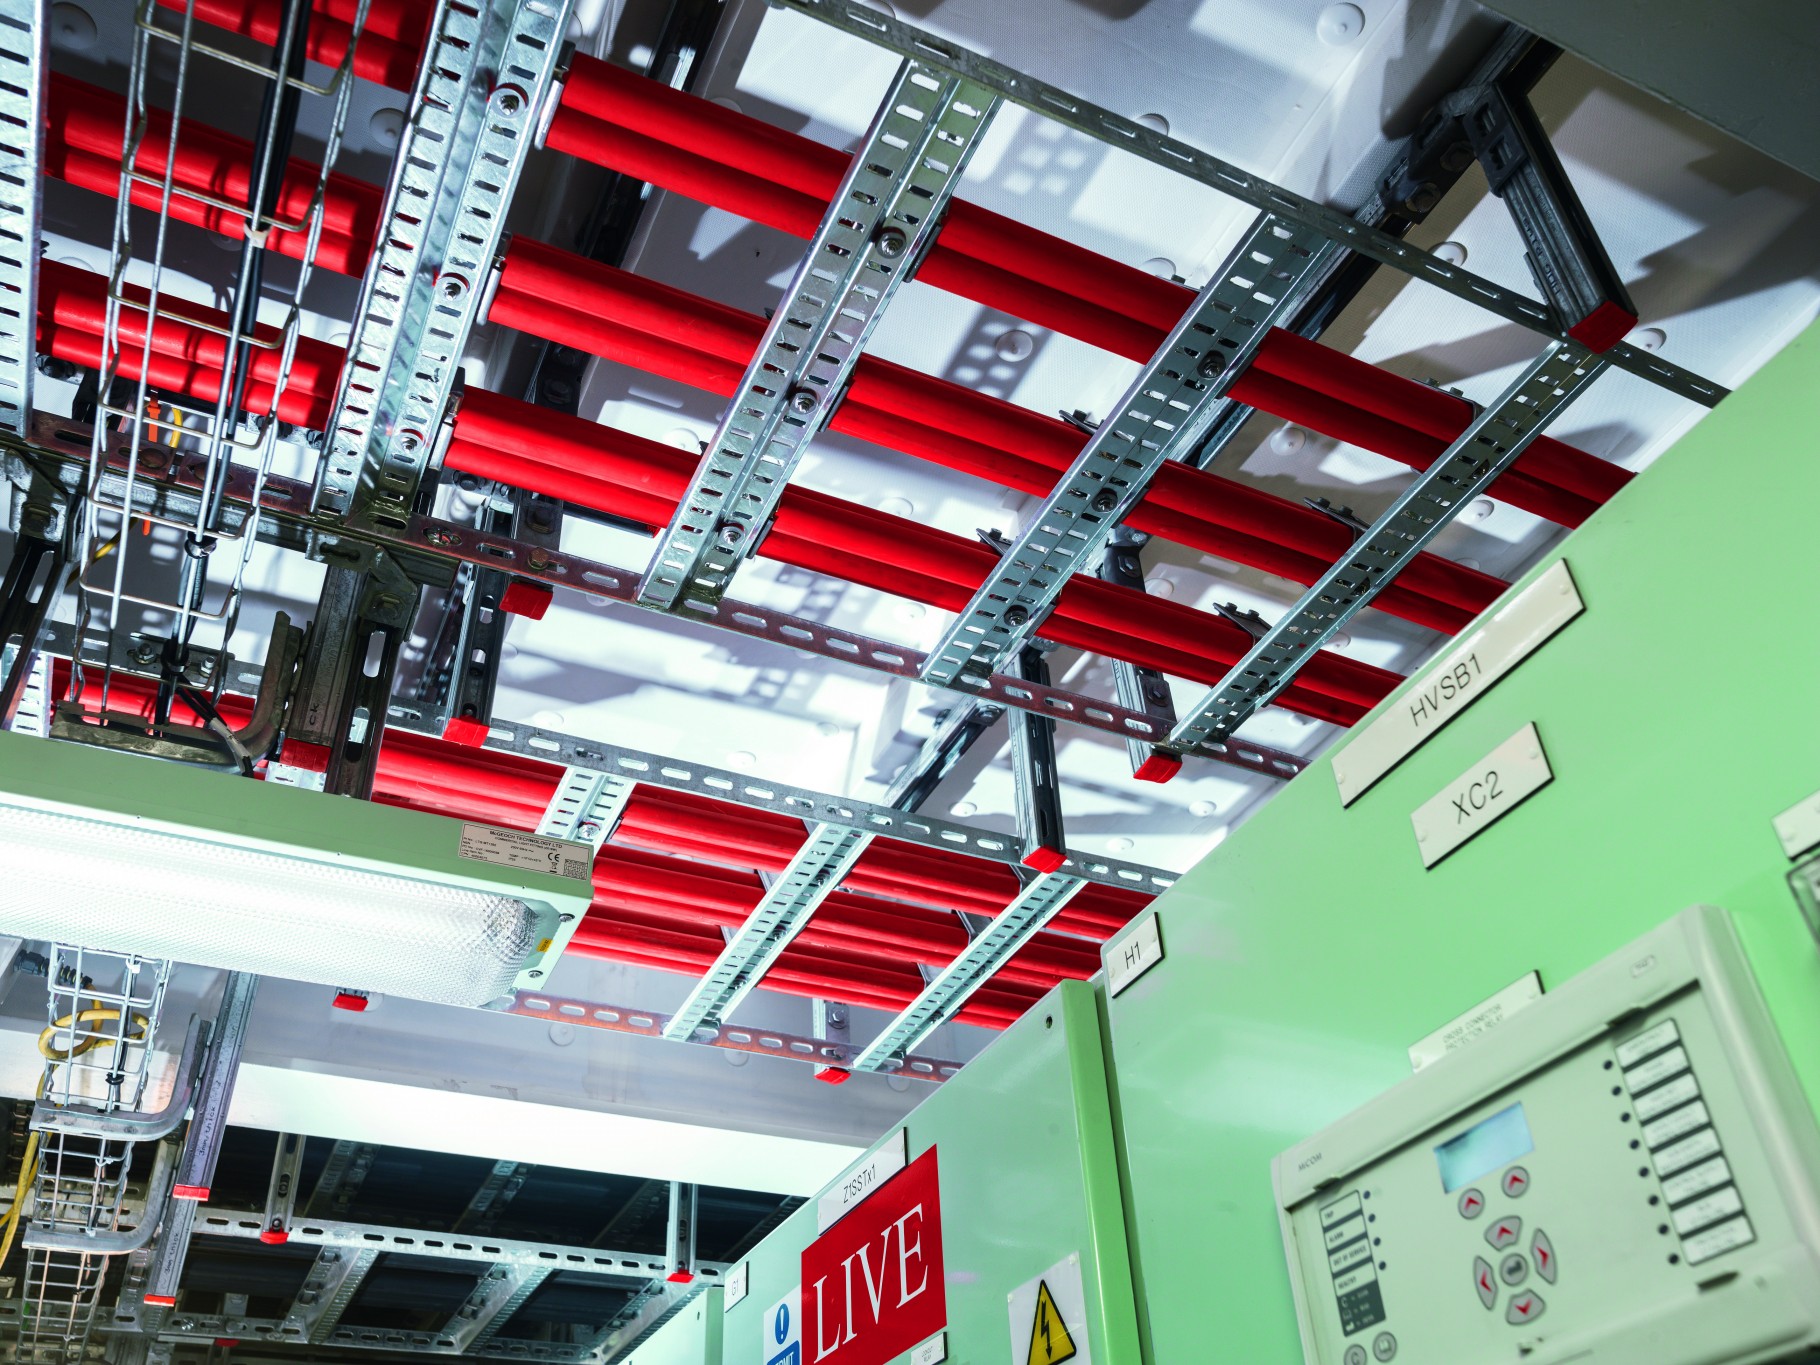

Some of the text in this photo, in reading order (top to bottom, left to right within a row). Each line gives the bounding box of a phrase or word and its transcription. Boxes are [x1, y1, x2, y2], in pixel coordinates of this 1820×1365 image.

[1410, 653, 1483, 727] HVSB1
[1451, 770, 1503, 825] XC2
[516, 835, 552, 847] TECHNOLOGY
[1124, 941, 1141, 970] H1
[843, 1163, 876, 1204] Z1SSTx1
[731, 1279, 740, 1296] G1
[812, 1202, 929, 1364] LIVE
